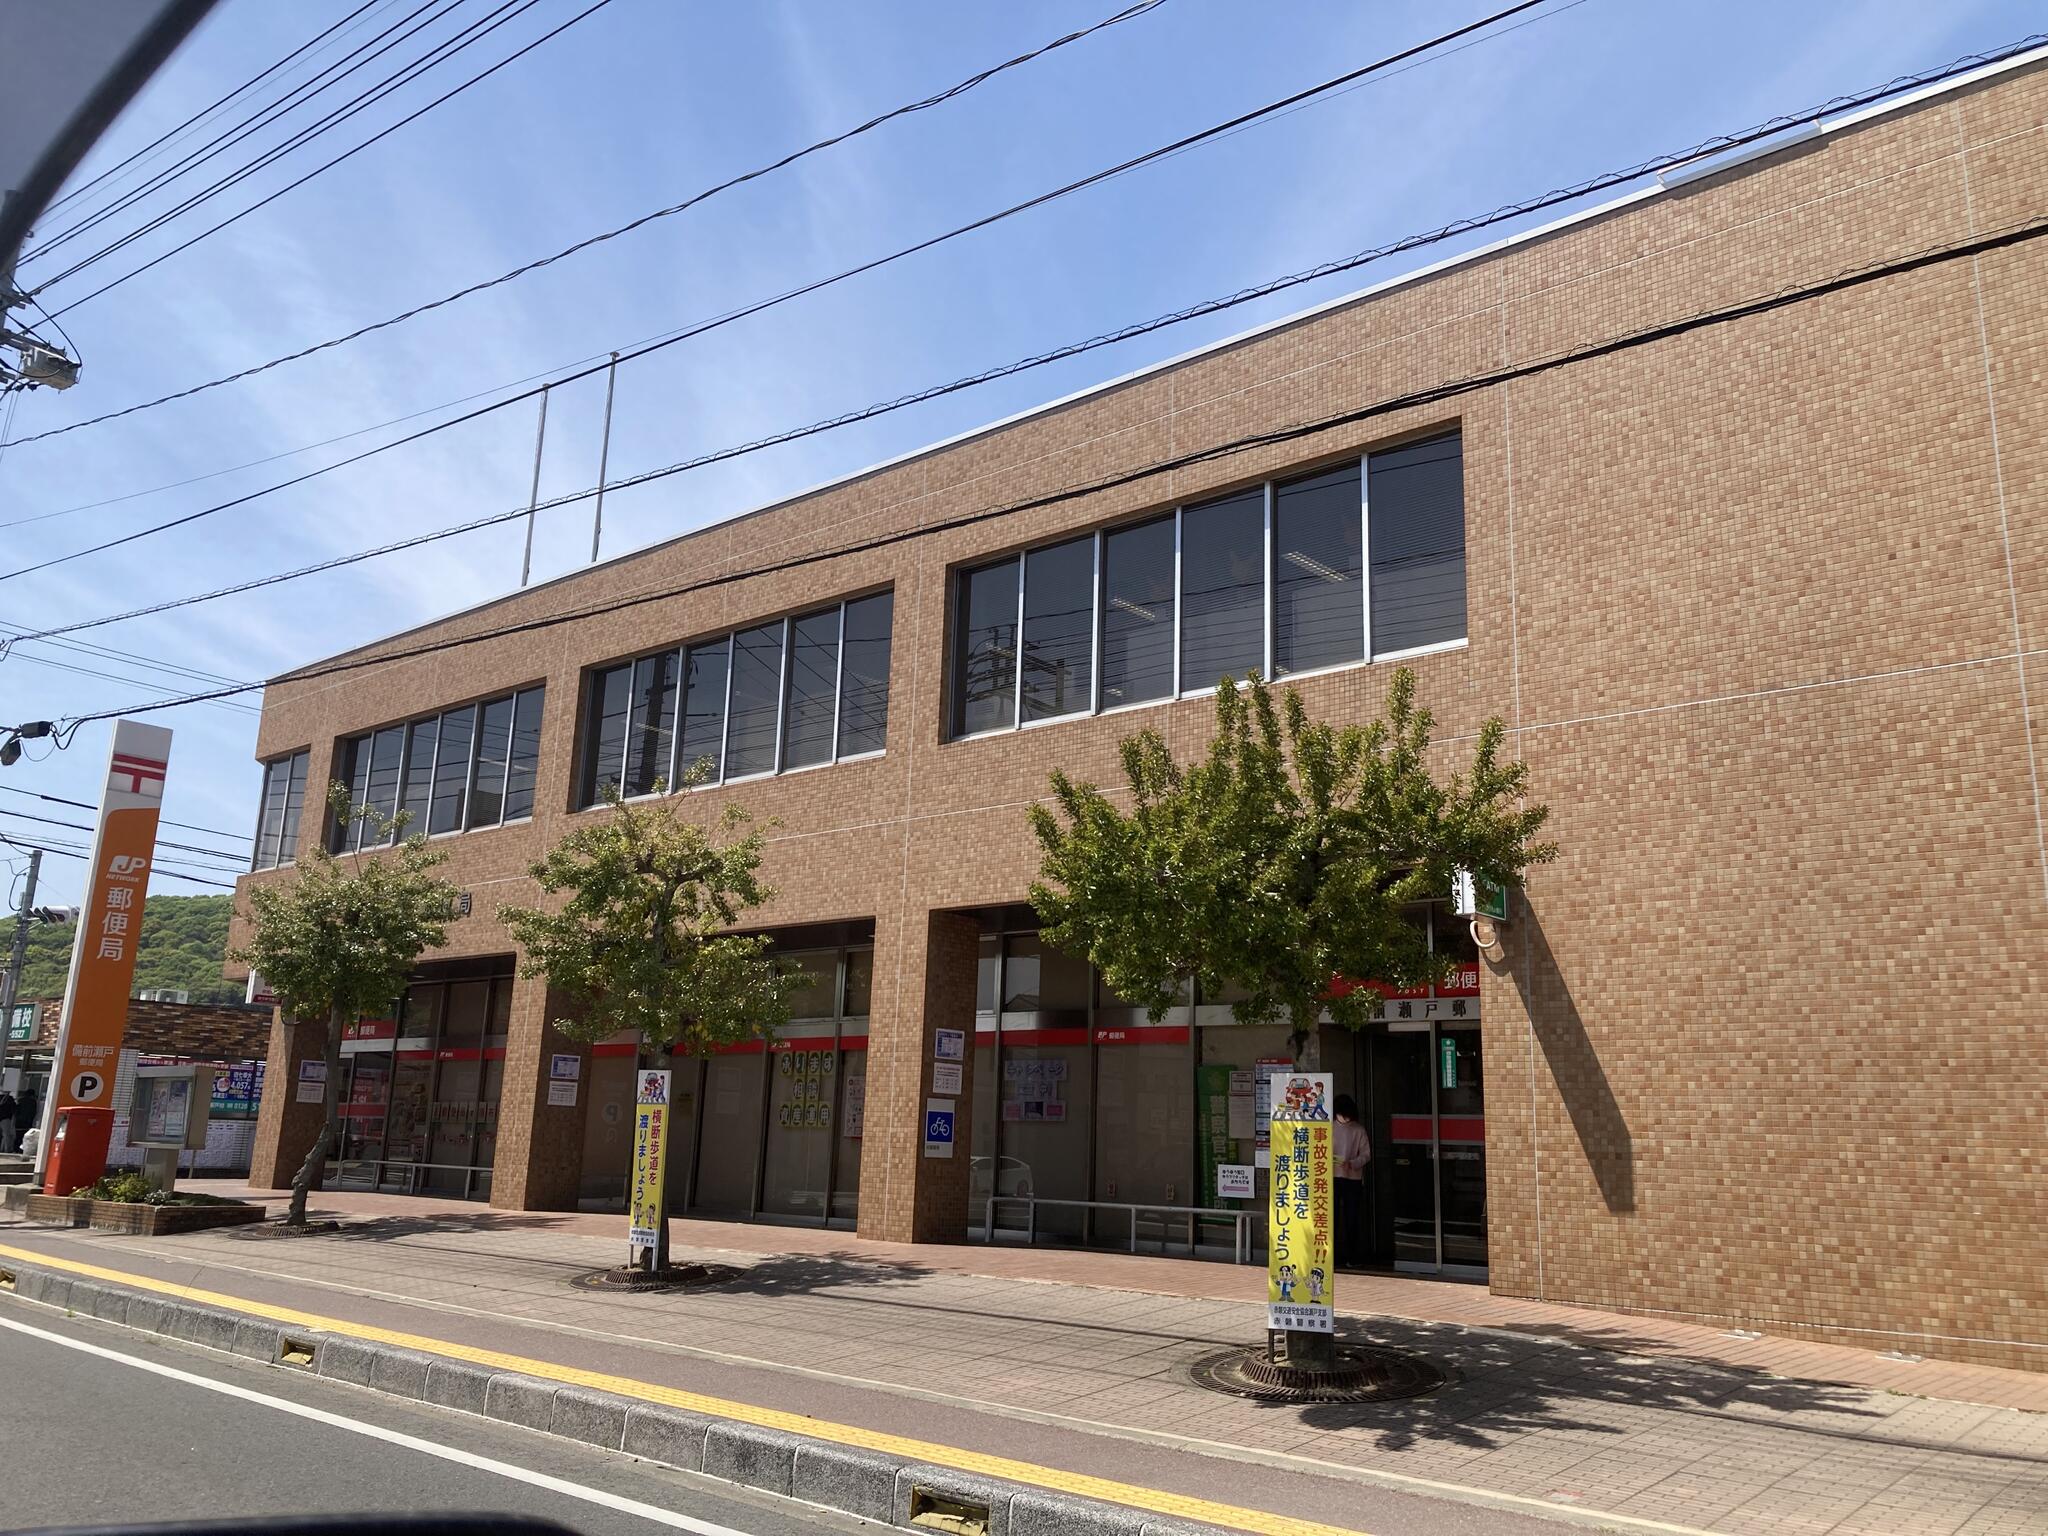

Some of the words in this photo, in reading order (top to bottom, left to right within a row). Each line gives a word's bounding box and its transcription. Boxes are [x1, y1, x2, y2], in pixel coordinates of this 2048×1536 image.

[106, 874, 140, 882] NETWORK
[97, 887, 134, 962] 郵便局
[1445, 971, 1480, 990] 郵便
[78, 1076, 97, 1097] P
[635, 1114, 649, 1201] 渡りましょう
[648, 1109, 662, 1186] 横断歩道を
[1293, 1127, 1309, 1220] 横断歩道を
[1275, 1155, 1291, 1261] 渡りましょう
